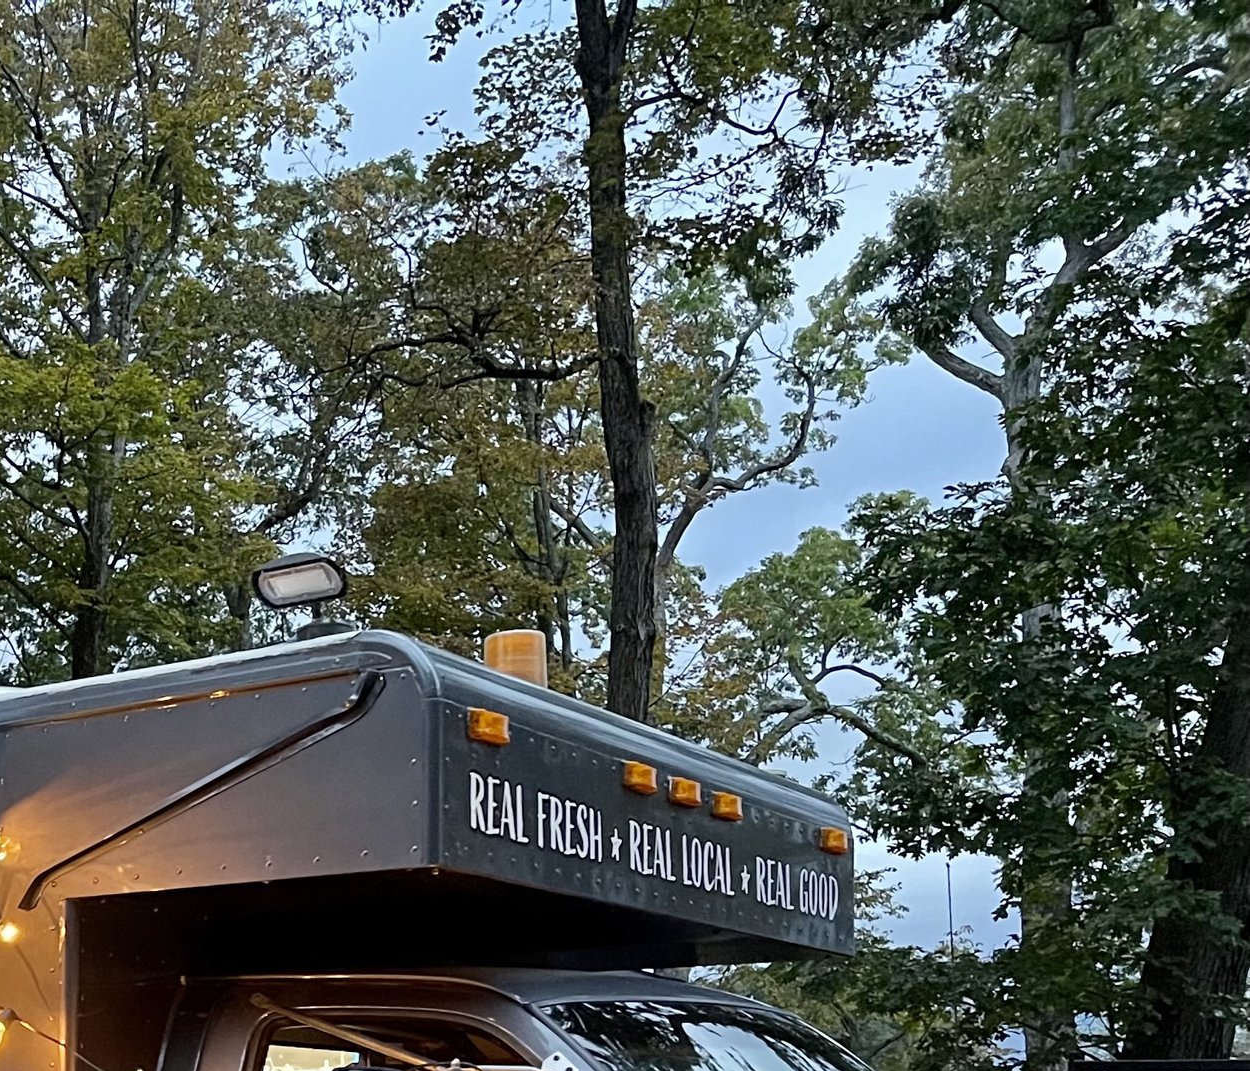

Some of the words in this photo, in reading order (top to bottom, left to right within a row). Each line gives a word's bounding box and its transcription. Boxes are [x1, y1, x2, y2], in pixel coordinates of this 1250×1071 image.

[469, 771, 530, 844] REAL
[537, 792, 603, 863] FRESH
[629, 819, 677, 882] REAL
[682, 833, 735, 896] LOCAL
[755, 855, 795, 910] REAL
[799, 867, 839, 921] GOOD
